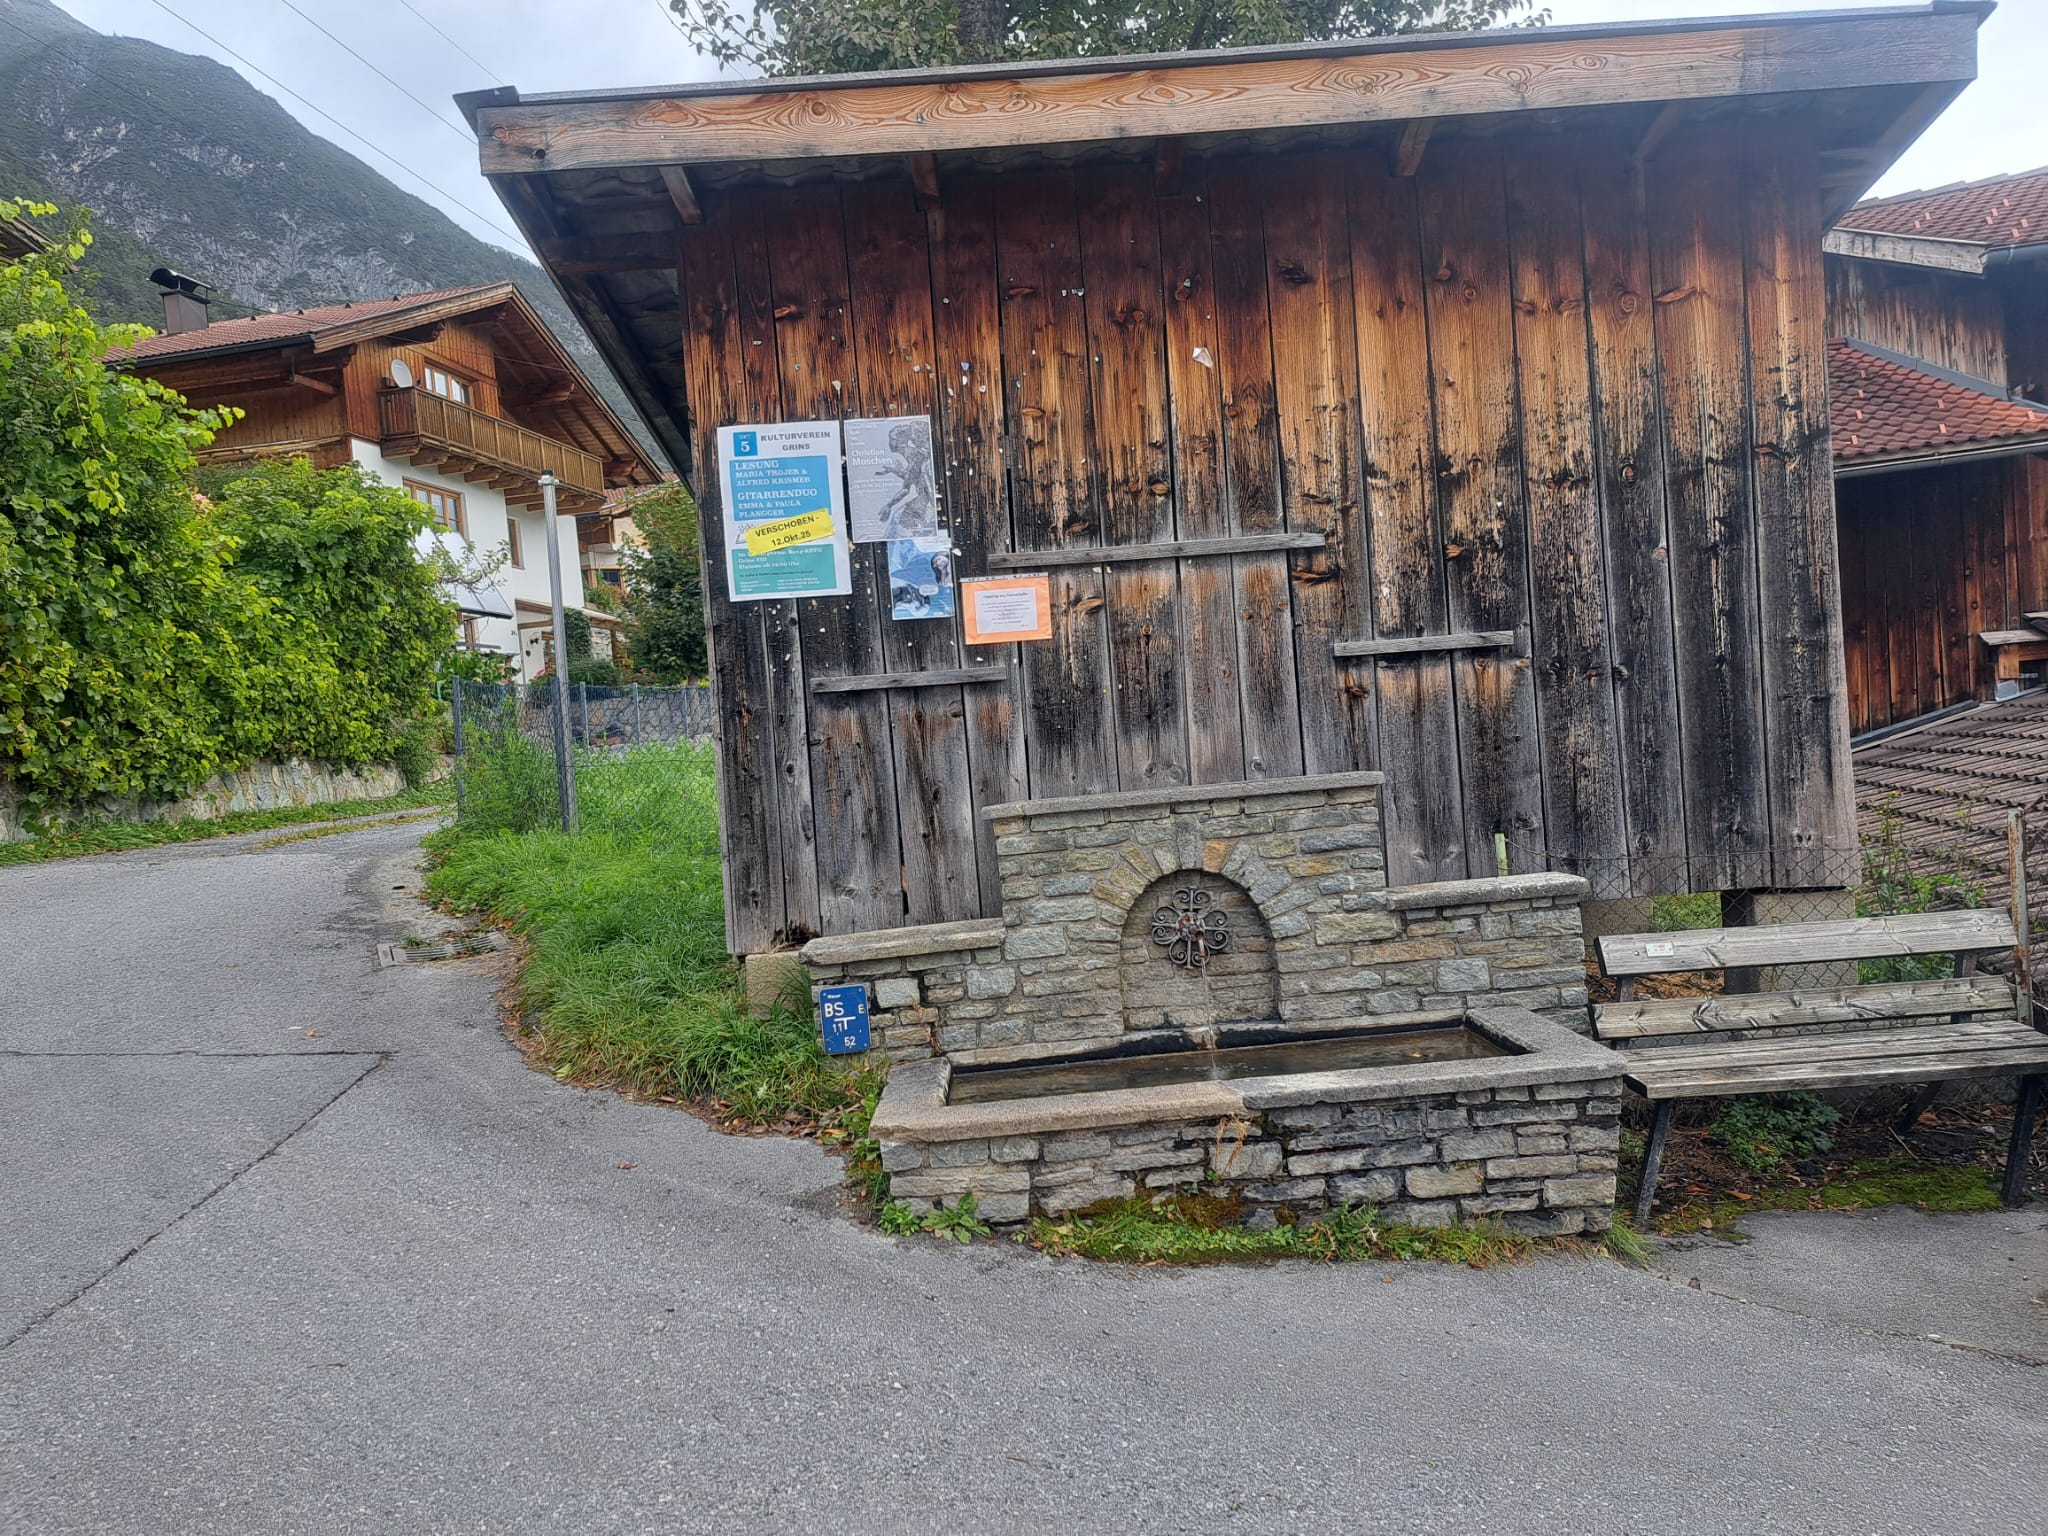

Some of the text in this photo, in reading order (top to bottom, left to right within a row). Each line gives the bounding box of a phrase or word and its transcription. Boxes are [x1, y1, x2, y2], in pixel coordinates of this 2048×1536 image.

[760, 431, 831, 442] KULTURVEREIN
[740, 441, 750, 453] 5
[782, 443, 810, 451] GRINS
[851, 449, 885, 457] Christian
[735, 460, 779, 471] LESUNG
[735, 469, 764, 478] MARIA
[736, 479, 770, 487] ALFRED
[737, 488, 818, 501] GITARRENDUO
[774, 499, 801, 507] PAULA
[754, 515, 815, 537] VERSCHOBEN
[771, 530, 811, 547] 12.Okt.25
[824, 1001, 845, 1018] BS
[858, 1003, 865, 1014] E
